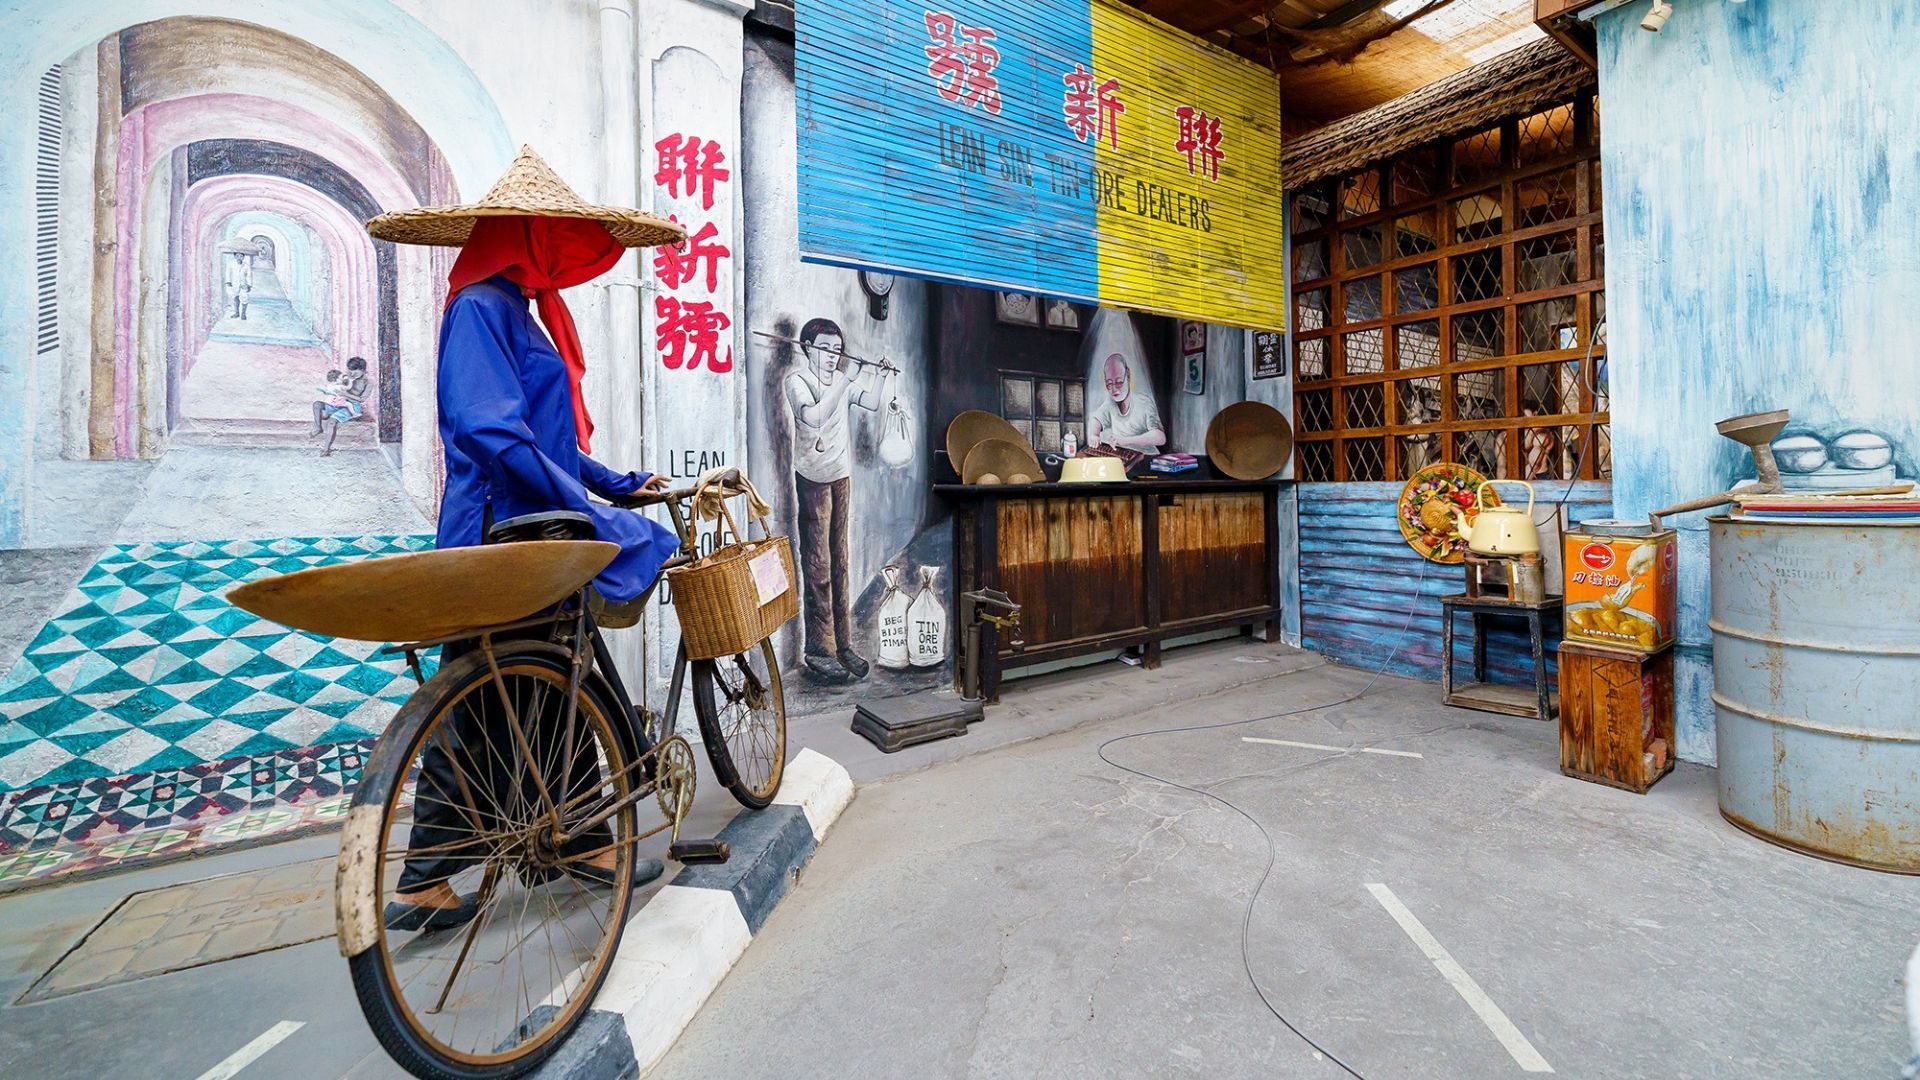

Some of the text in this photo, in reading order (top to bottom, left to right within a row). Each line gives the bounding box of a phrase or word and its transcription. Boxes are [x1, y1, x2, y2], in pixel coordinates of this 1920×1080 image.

[938, 121, 986, 177] LEAN
[998, 140, 1034, 188] SIN
[1137, 180, 1212, 233] DEALERS
[1189, 359, 1199, 381] 5
[670, 450, 725, 478] LEAN
[884, 615, 903, 626] BEG
[916, 621, 939, 633] TIN
[919, 633, 938, 644] ORE
[919, 644, 938, 655] BAG
